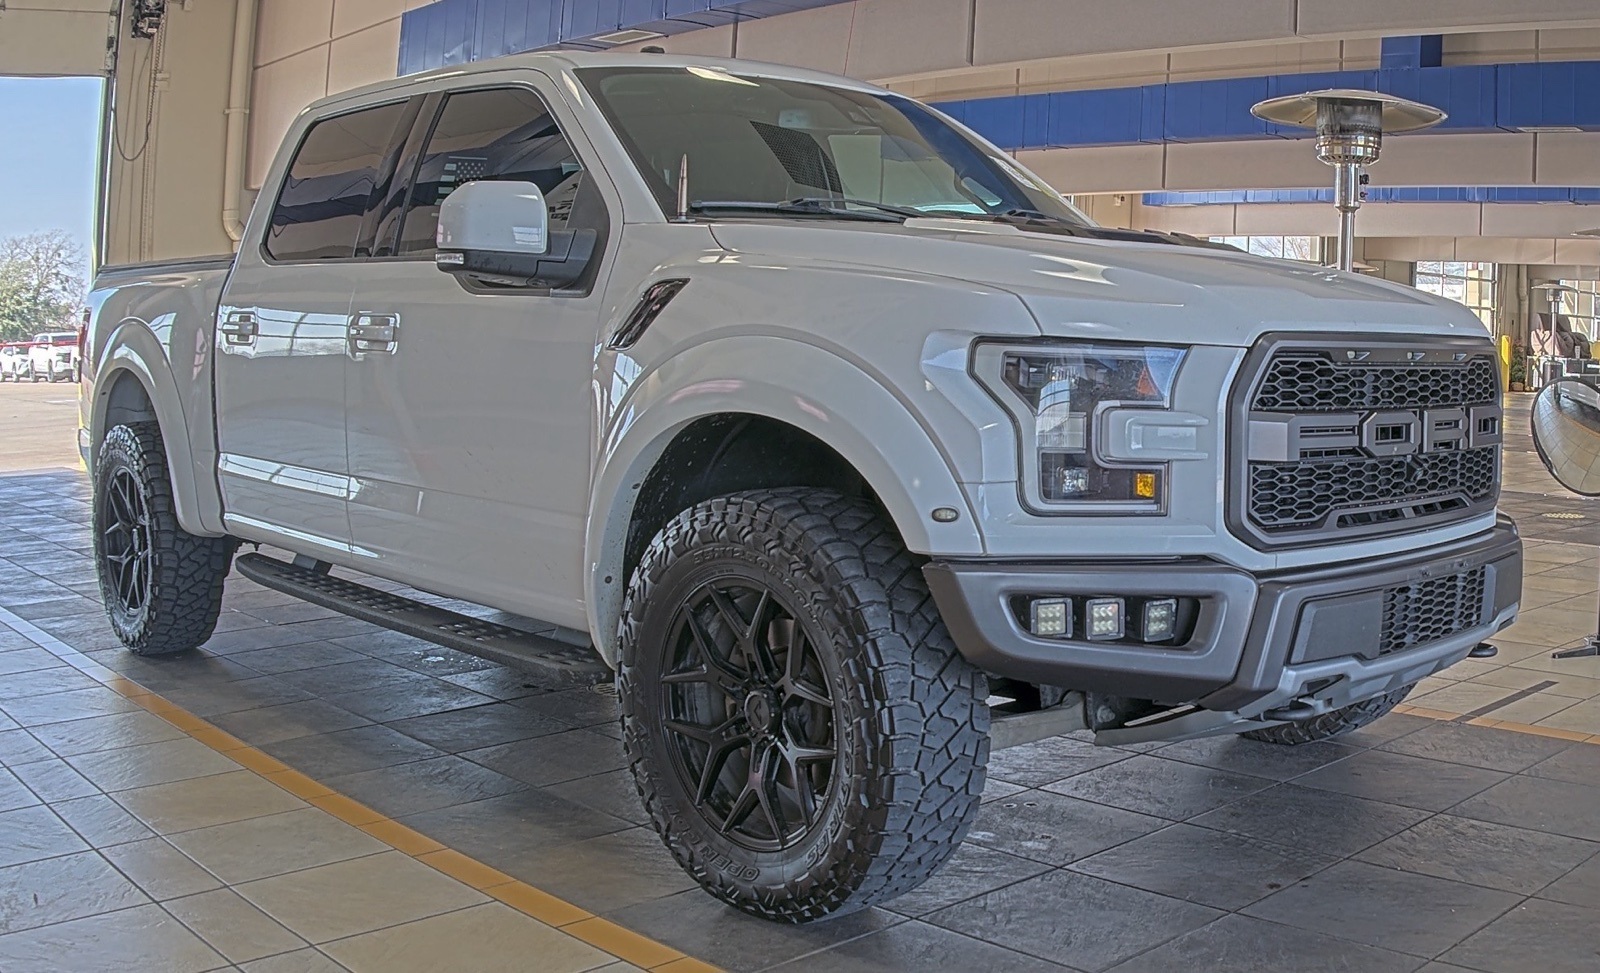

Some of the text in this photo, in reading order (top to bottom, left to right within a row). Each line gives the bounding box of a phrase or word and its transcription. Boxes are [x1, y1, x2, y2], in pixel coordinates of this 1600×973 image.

[1285, 406, 1502, 462] FORD
[805, 779, 851, 869] TIRES
[699, 844, 760, 882] OPEN
